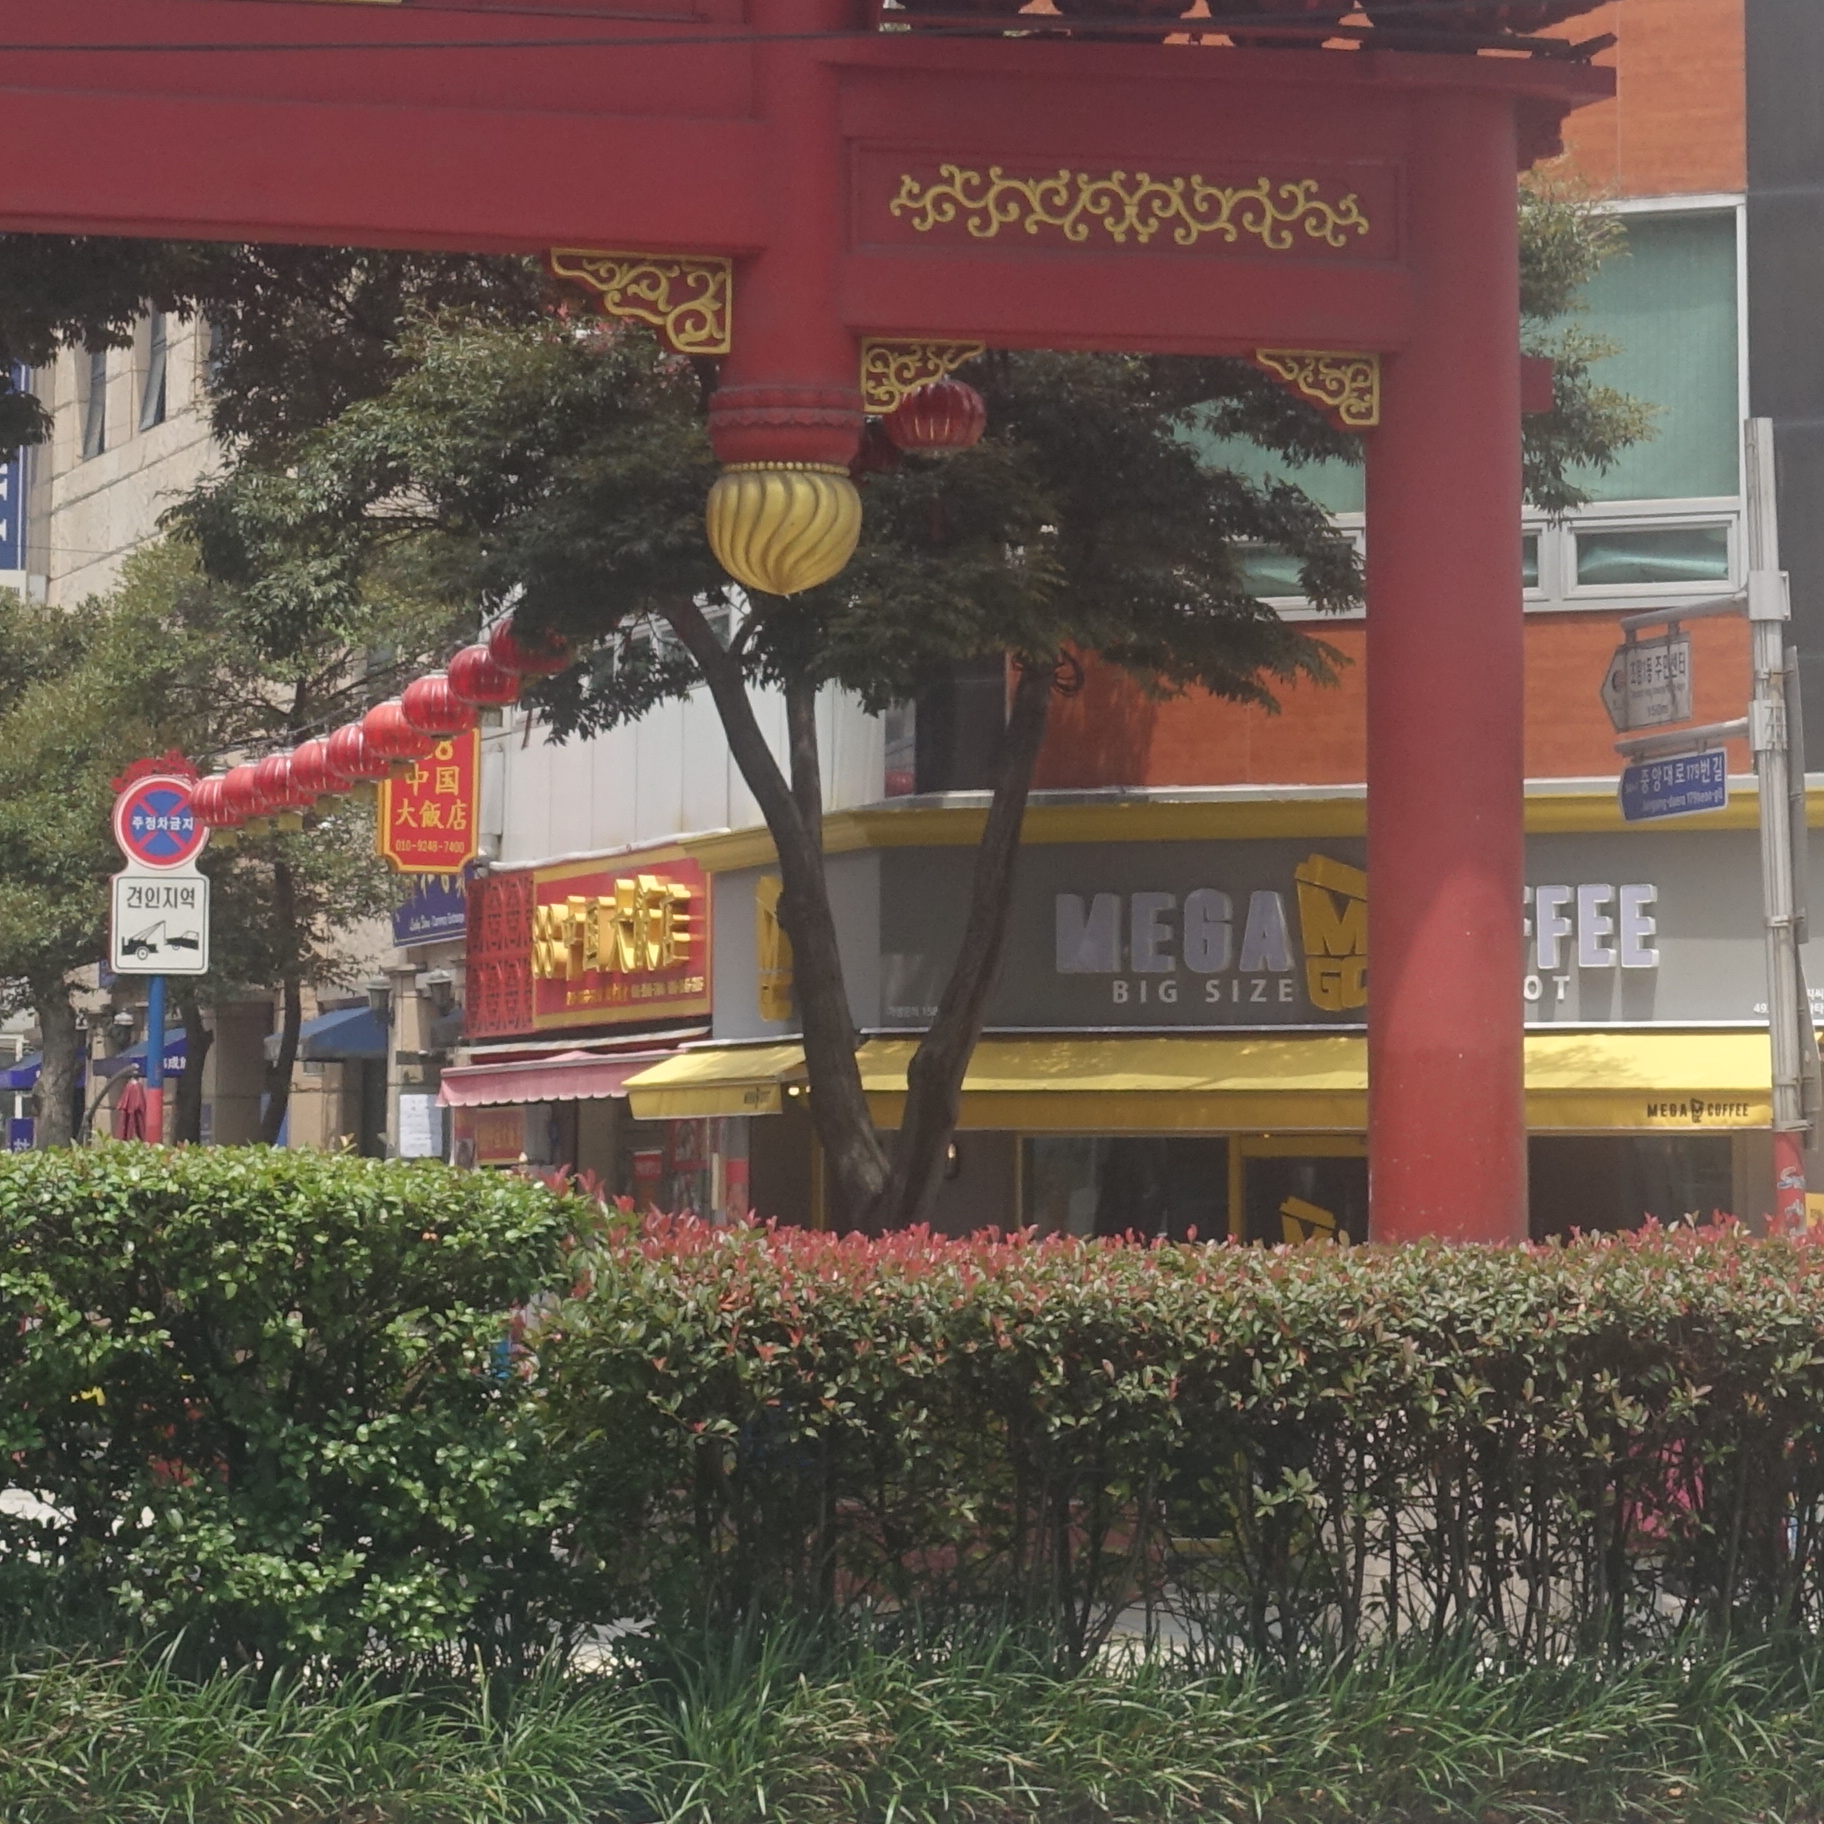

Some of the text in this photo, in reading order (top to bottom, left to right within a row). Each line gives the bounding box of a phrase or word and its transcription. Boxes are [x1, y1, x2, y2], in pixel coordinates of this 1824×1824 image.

[1640, 756, 1724, 794] 중앙대로179번길
[131, 816, 194, 831] 주정차금지
[395, 839, 465, 854] 010-9248-7400
[127, 887, 195, 909] 견인지역
[1055, 888, 1296, 974] MEGA
[1111, 979, 1178, 1004] BIG
[1204, 978, 1294, 1004] SIZE
[1647, 1102, 1749, 1118] MEGA COFFEE
